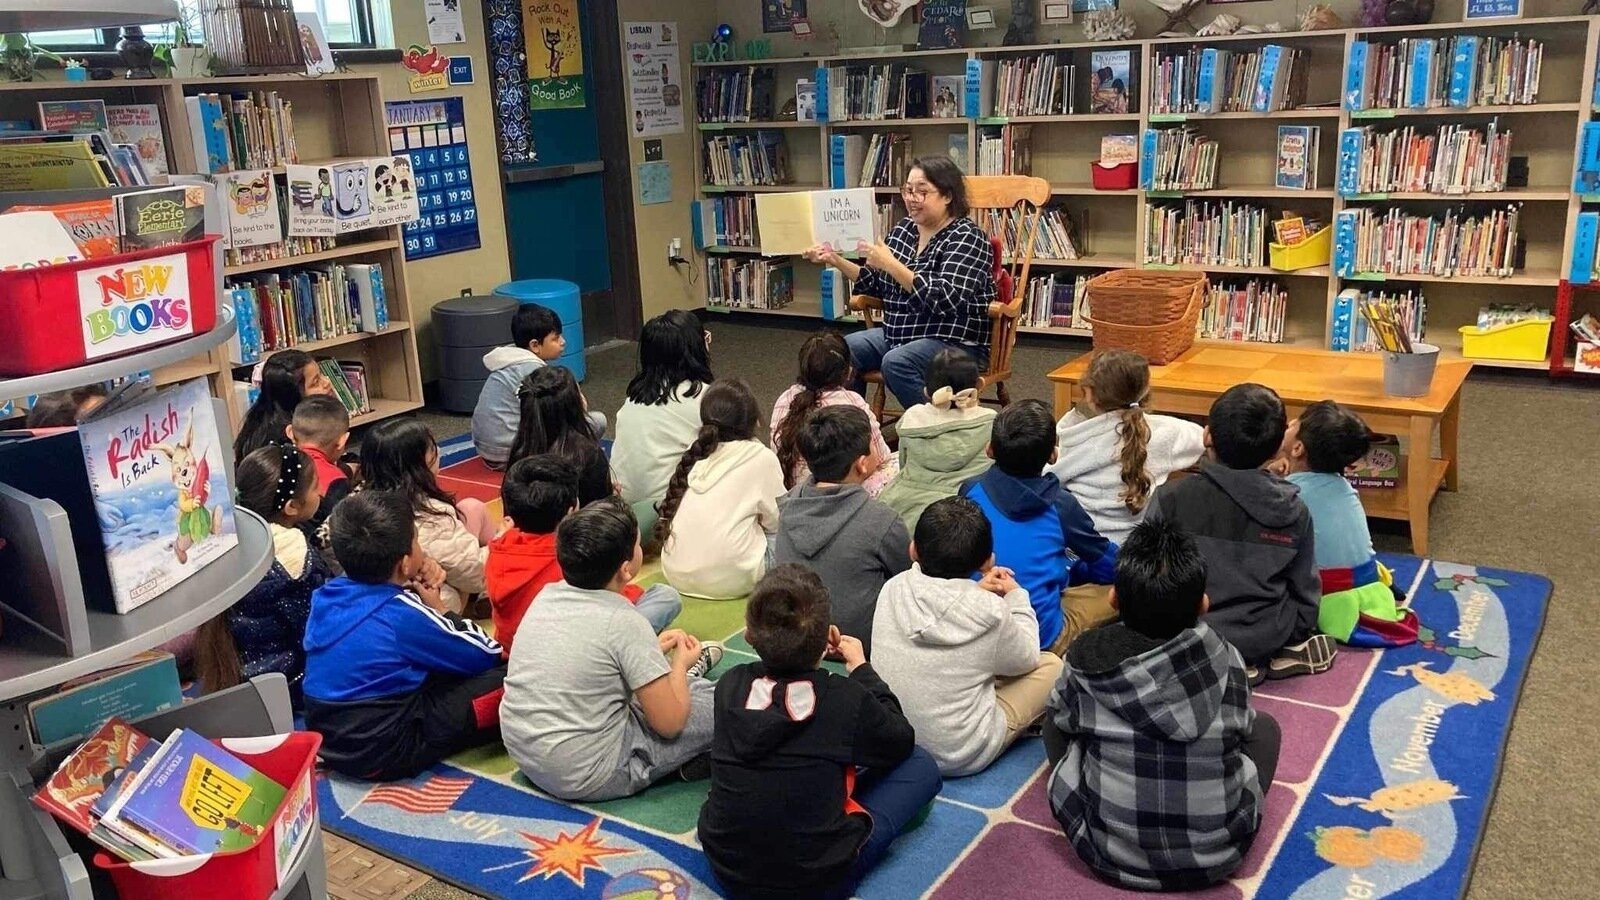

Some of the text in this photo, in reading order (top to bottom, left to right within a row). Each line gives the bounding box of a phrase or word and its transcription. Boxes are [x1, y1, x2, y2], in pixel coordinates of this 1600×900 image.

[528, 3, 569, 17] Rock Out
[556, 17, 562, 25] A
[629, 26, 652, 34] LIBRARY
[453, 66, 467, 74] EXIT
[413, 77, 442, 89] winter
[531, 82, 582, 100] Good Book
[386, 104, 432, 126] JANUARY
[414, 150, 465, 166] 3 4 5 6
[416, 170, 468, 187] 10 11 12 13
[419, 190, 472, 207] 17 18 19 20
[845, 197, 850, 208] A
[139, 207, 185, 223] Eerie
[388, 203, 400, 211] kind
[378, 217, 394, 225] each
[407, 209, 475, 231] 23 24 25 26 27
[824, 209, 861, 222] UNICORN
[138, 217, 186, 233] Elementary
[233, 226, 242, 234] Be
[244, 225, 255, 233] kind
[342, 222, 352, 230] Be
[407, 236, 434, 250] 30 31
[96, 263, 174, 306] NEW
[85, 297, 189, 345] BOOKS
[107, 402, 179, 479] Radish
[122, 425, 140, 443] The
[121, 453, 160, 489] Is Back
[1447, 590, 1490, 641] December
[1389, 698, 1447, 775] November
[198, 767, 242, 810] LEFT
[192, 798, 224, 826] GO
[448, 810, 507, 840] July
